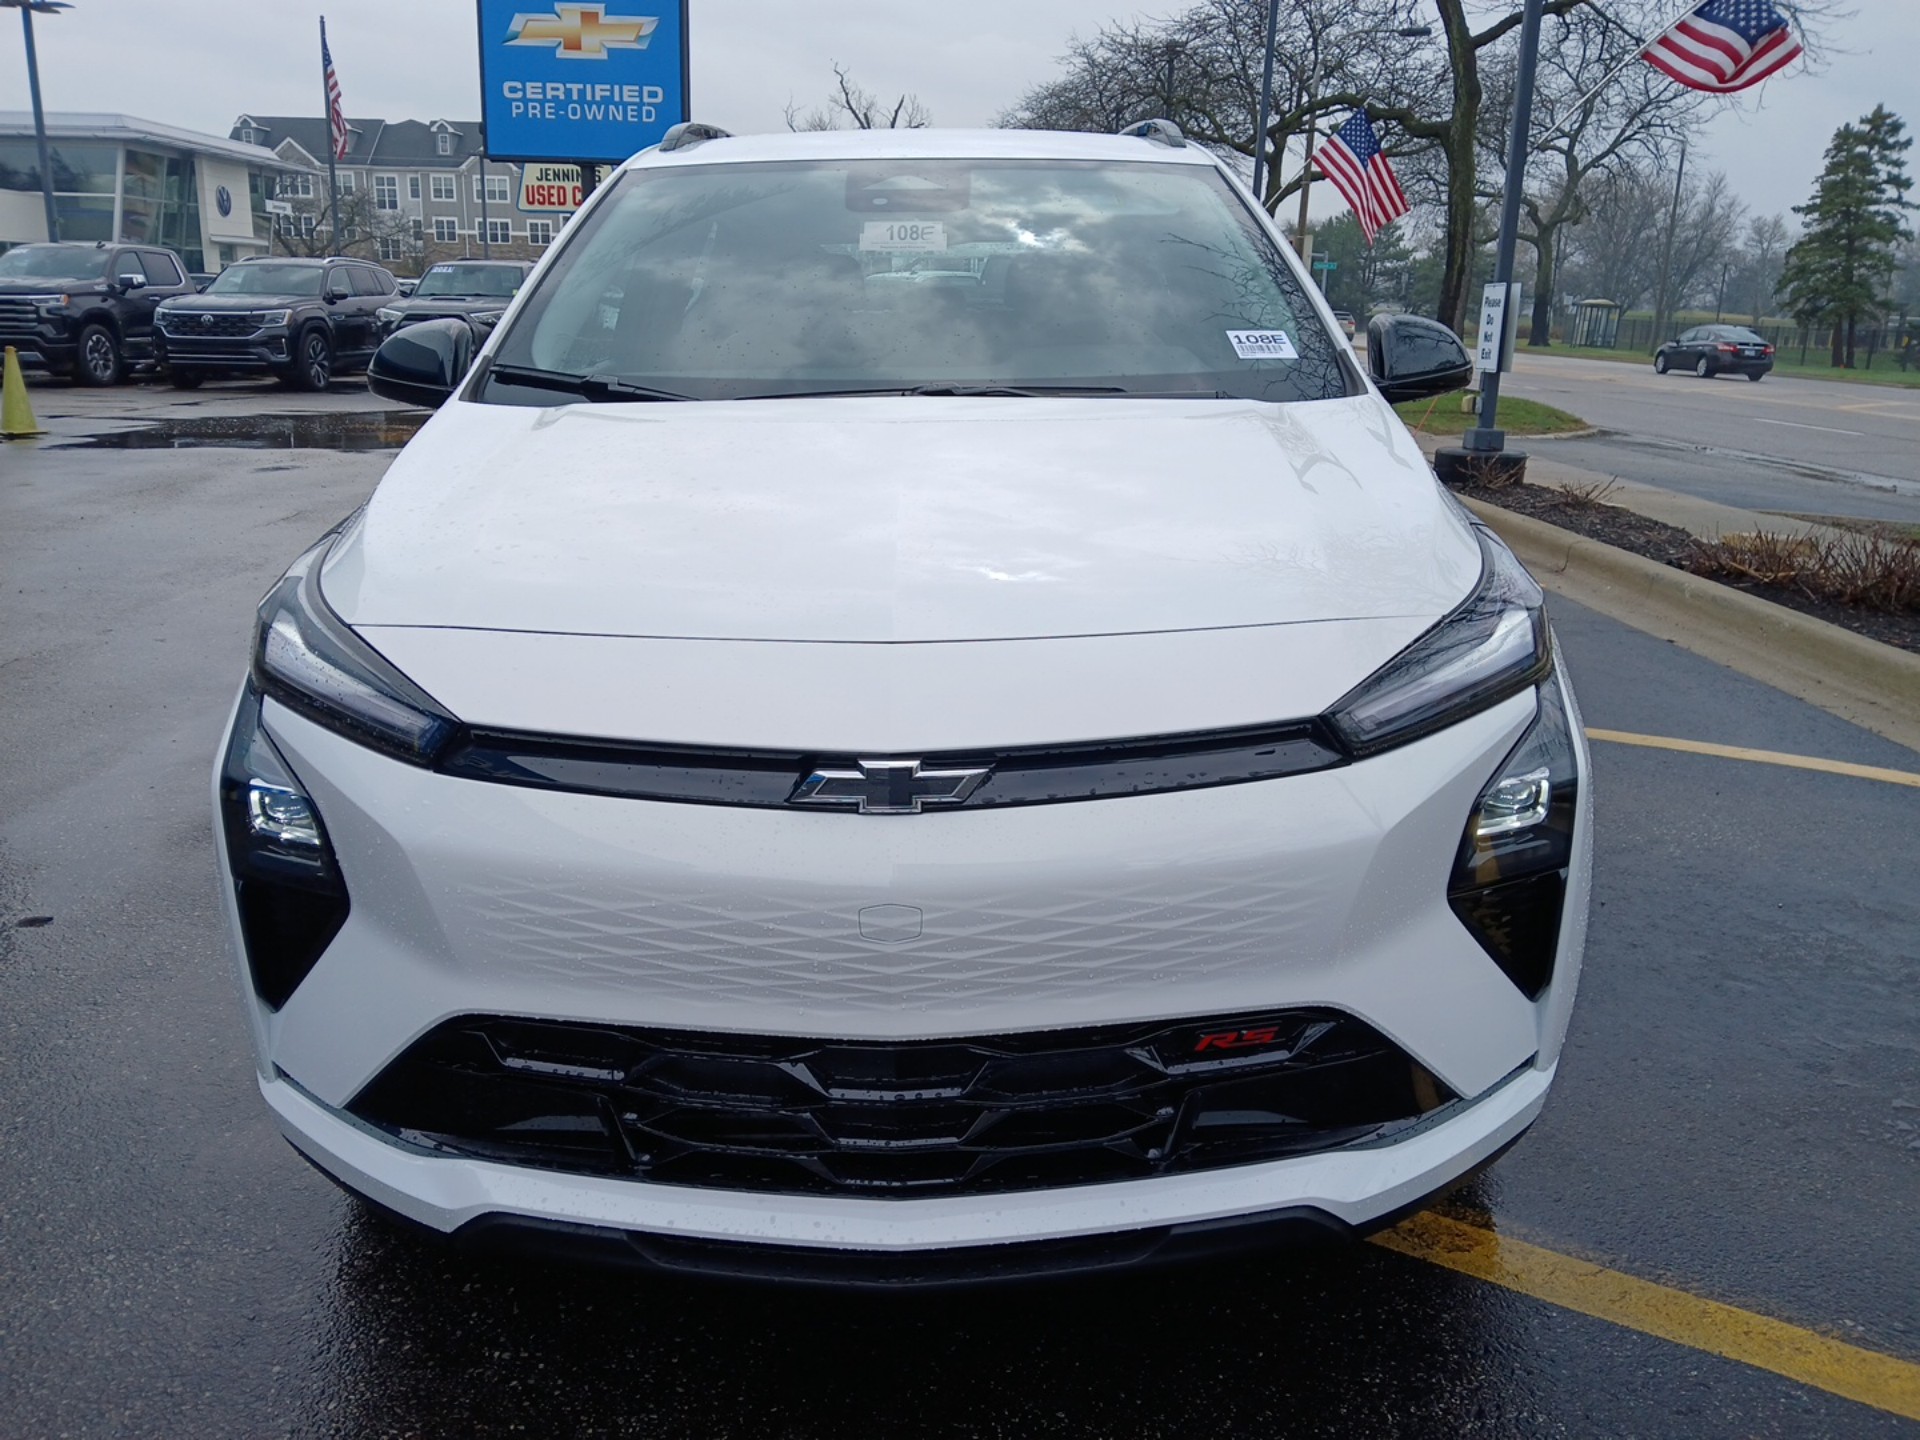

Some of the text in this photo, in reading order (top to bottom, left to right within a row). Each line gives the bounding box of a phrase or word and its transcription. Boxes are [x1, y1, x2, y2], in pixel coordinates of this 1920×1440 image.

[502, 81, 664, 104] CERTIFIED
[511, 102, 656, 122] PRE-OWNED
[525, 184, 568, 206] USED
[886, 225, 935, 241] 108E
[1484, 296, 1501, 308] Please
[1486, 313, 1494, 326] Do
[1234, 334, 1287, 344] 108E
[1483, 331, 1493, 343] Not
[1481, 348, 1492, 360] Exit
[1195, 1026, 1280, 1051] RS
